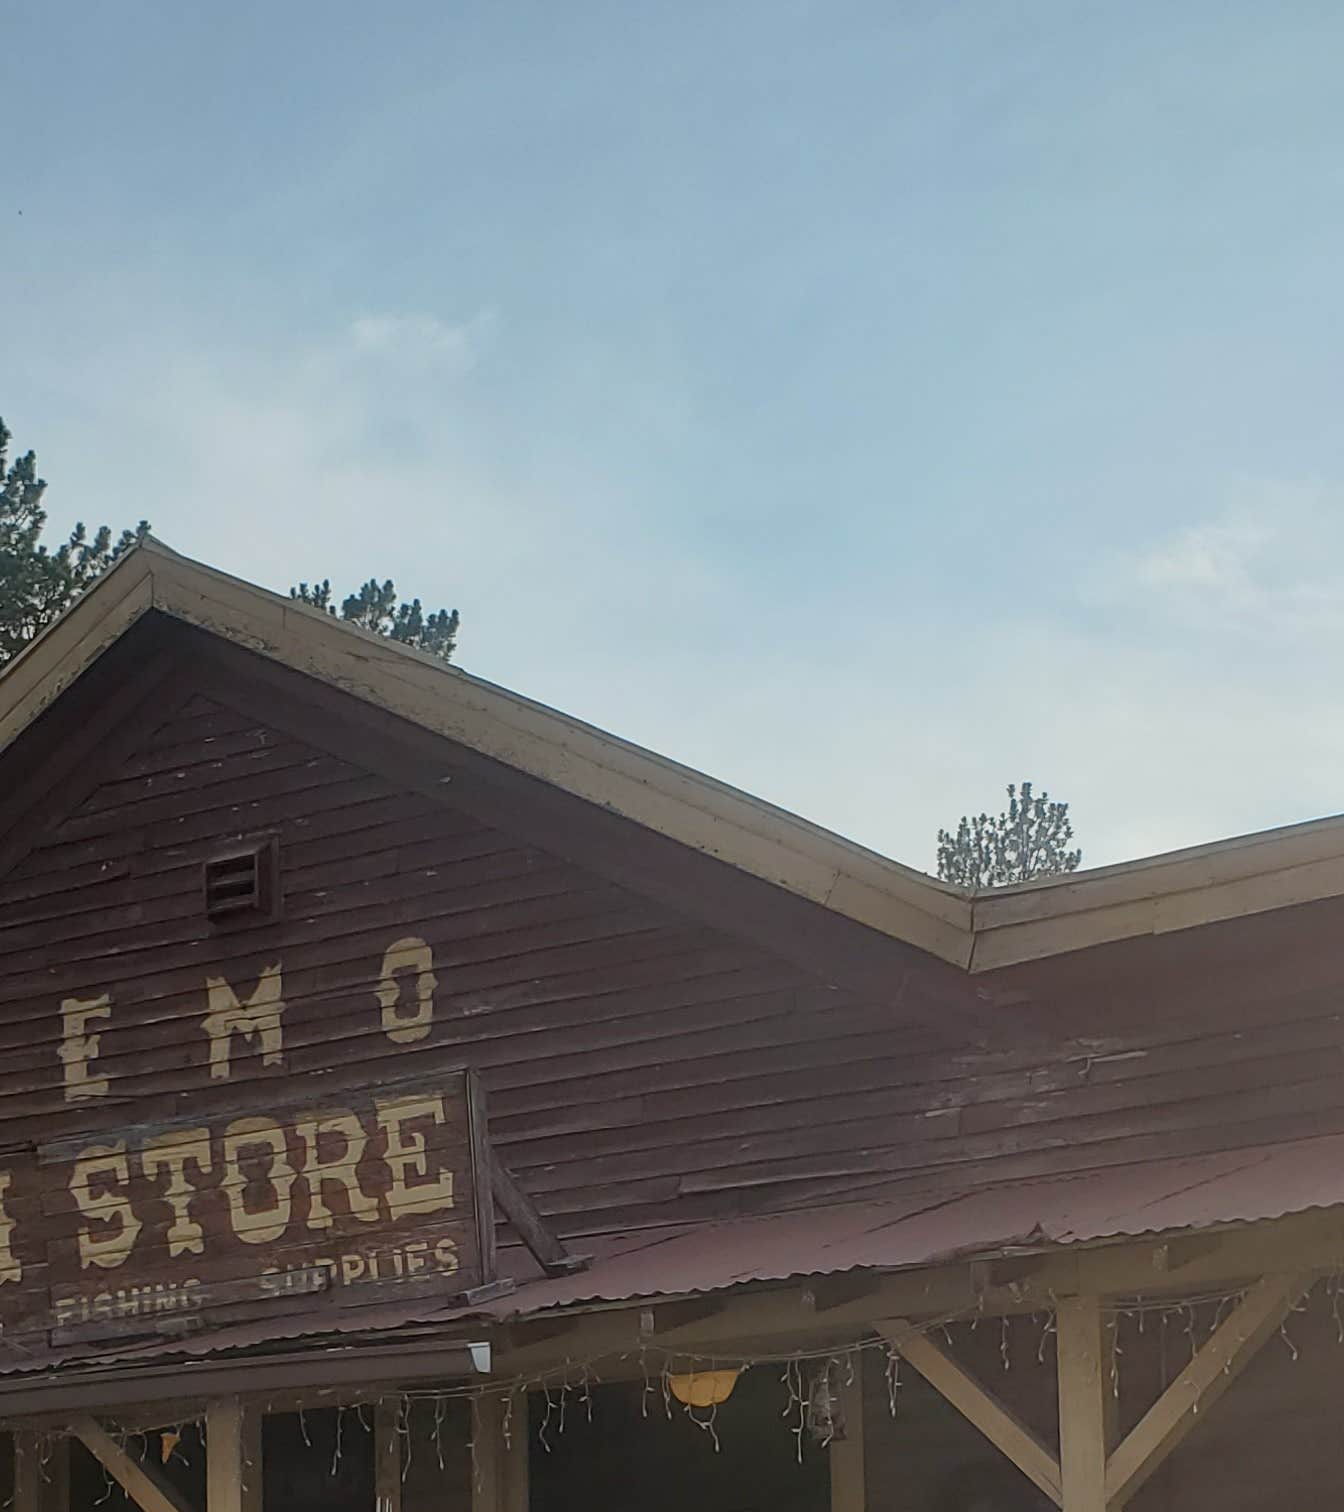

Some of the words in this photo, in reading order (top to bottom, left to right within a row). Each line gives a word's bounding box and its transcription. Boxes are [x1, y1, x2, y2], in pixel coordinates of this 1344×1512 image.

[68, 1095, 454, 1270] STORE
[56, 1277, 202, 1326] FISHING
[258, 1238, 460, 1294] SUPPLIES
